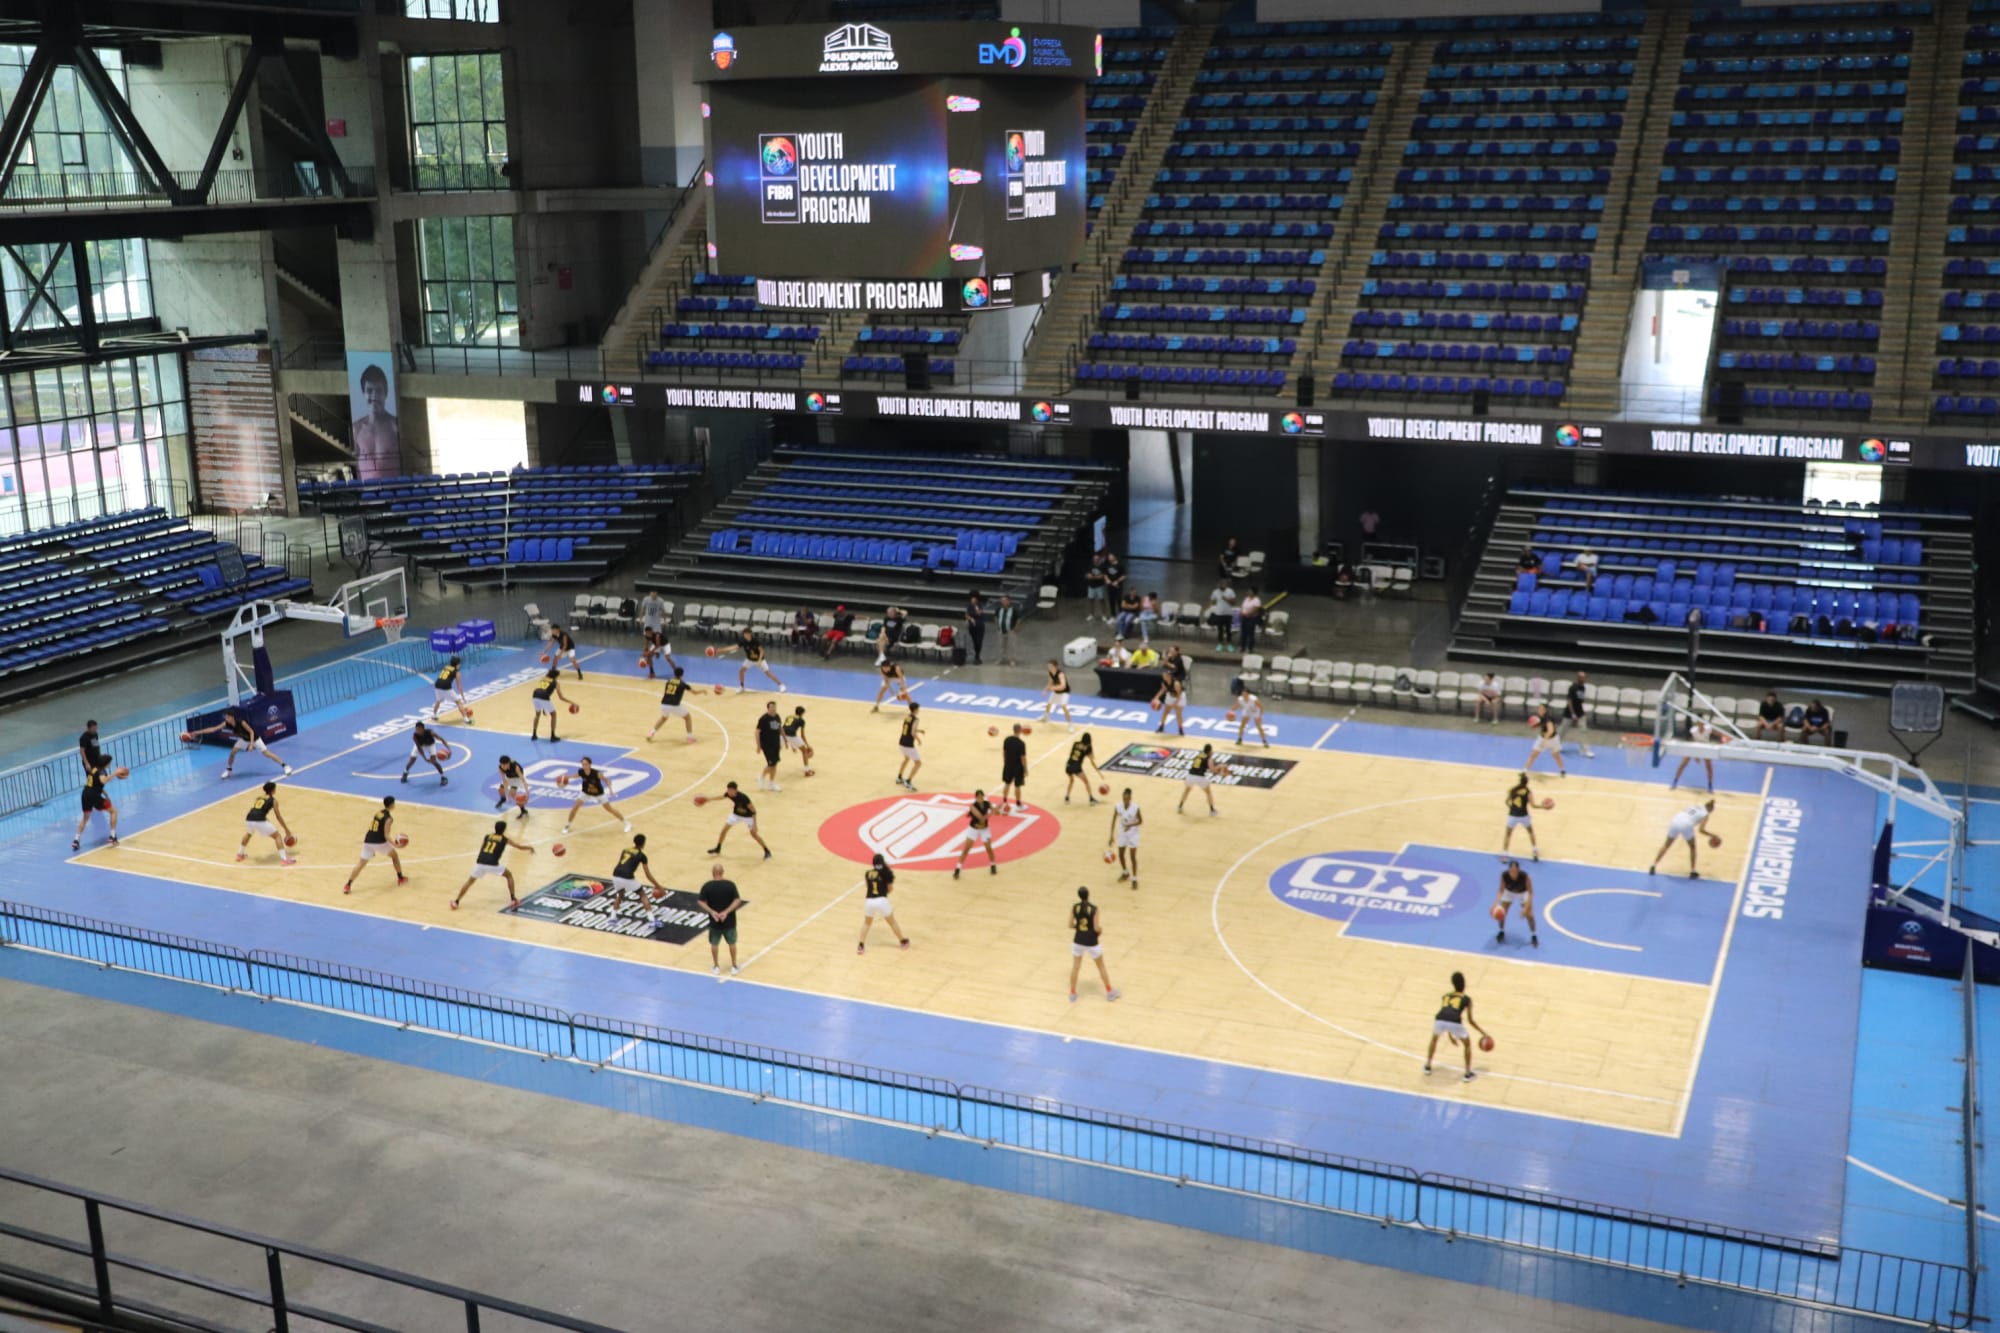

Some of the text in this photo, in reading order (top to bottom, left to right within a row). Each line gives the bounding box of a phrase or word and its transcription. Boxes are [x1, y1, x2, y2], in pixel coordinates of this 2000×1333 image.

[799, 132, 843, 159] YOUTH
[800, 164, 896, 192] DEVELOPMENT
[767, 184, 794, 200] FIBA
[801, 196, 870, 224] PROGRAM
[778, 281, 862, 310] DEVELOPMENT
[866, 281, 943, 310] PROGRAM
[666, 388, 796, 411] YOUTH DEVELOPMENT PROGRAM
[877, 396, 1020, 420] YOUTH DEVELOPMENT PROGRAM
[1110, 406, 1269, 432] YOUTH DEVELOPMENT PROGRAM
[1368, 417, 1542, 445] YOUTH DEVELOPMENT PROGRAM
[1651, 430, 1843, 460] YOUTH DEVELOPMENT PROGRAM
[1966, 444, 2000, 467] YOUT
[482, 840, 497, 853] 11
[620, 852, 631, 865] 7
[1285, 888, 1440, 918] AGUA ALCALINA
